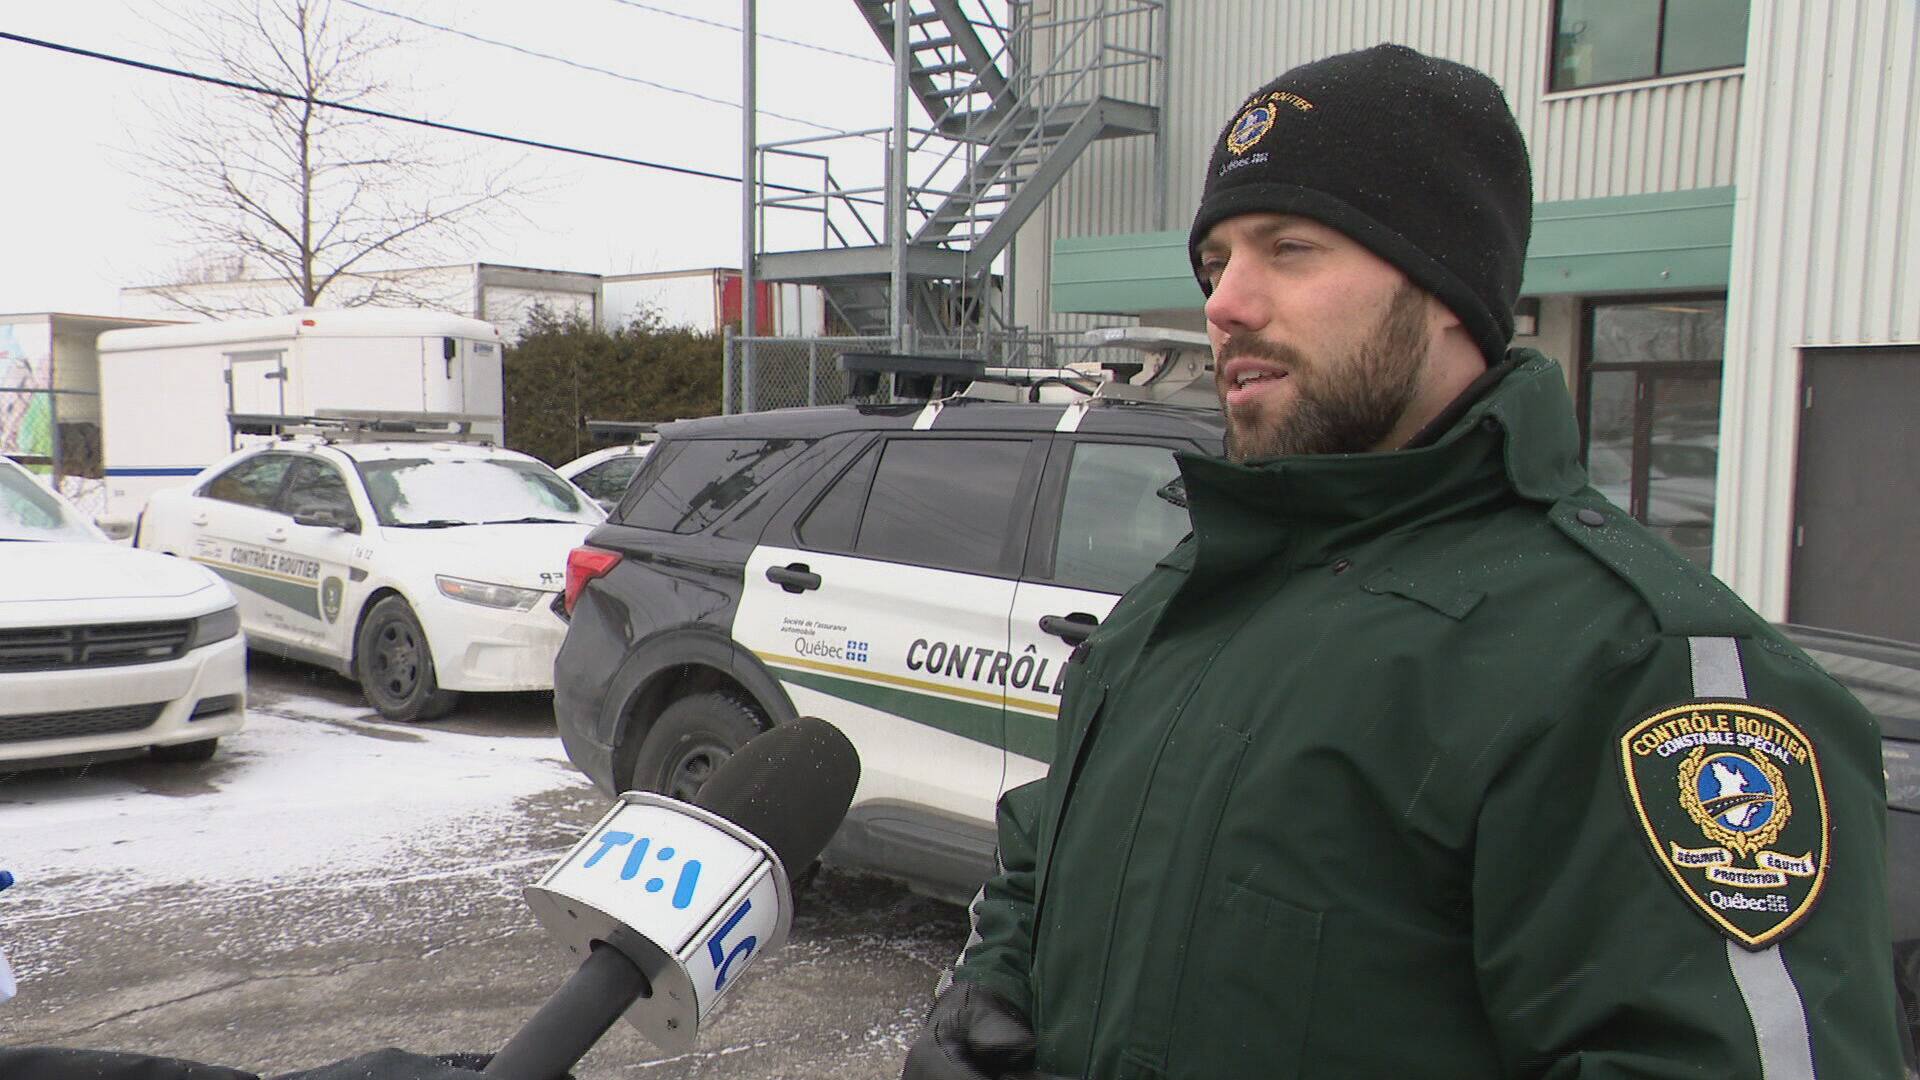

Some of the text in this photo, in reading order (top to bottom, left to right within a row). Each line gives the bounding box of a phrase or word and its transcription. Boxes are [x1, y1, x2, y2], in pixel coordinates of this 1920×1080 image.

[278, 555, 321, 580] ROUTIER
[805, 620, 813, 628] de
[795, 637, 843, 660] Québec
[1633, 712, 1808, 766] CONTRÔLE ROUTIER
[1656, 732, 1792, 766] CONSTABLE SPÉCIAL
[1713, 868, 1781, 885] PROTECTION
[1709, 890, 1768, 912] Québec
